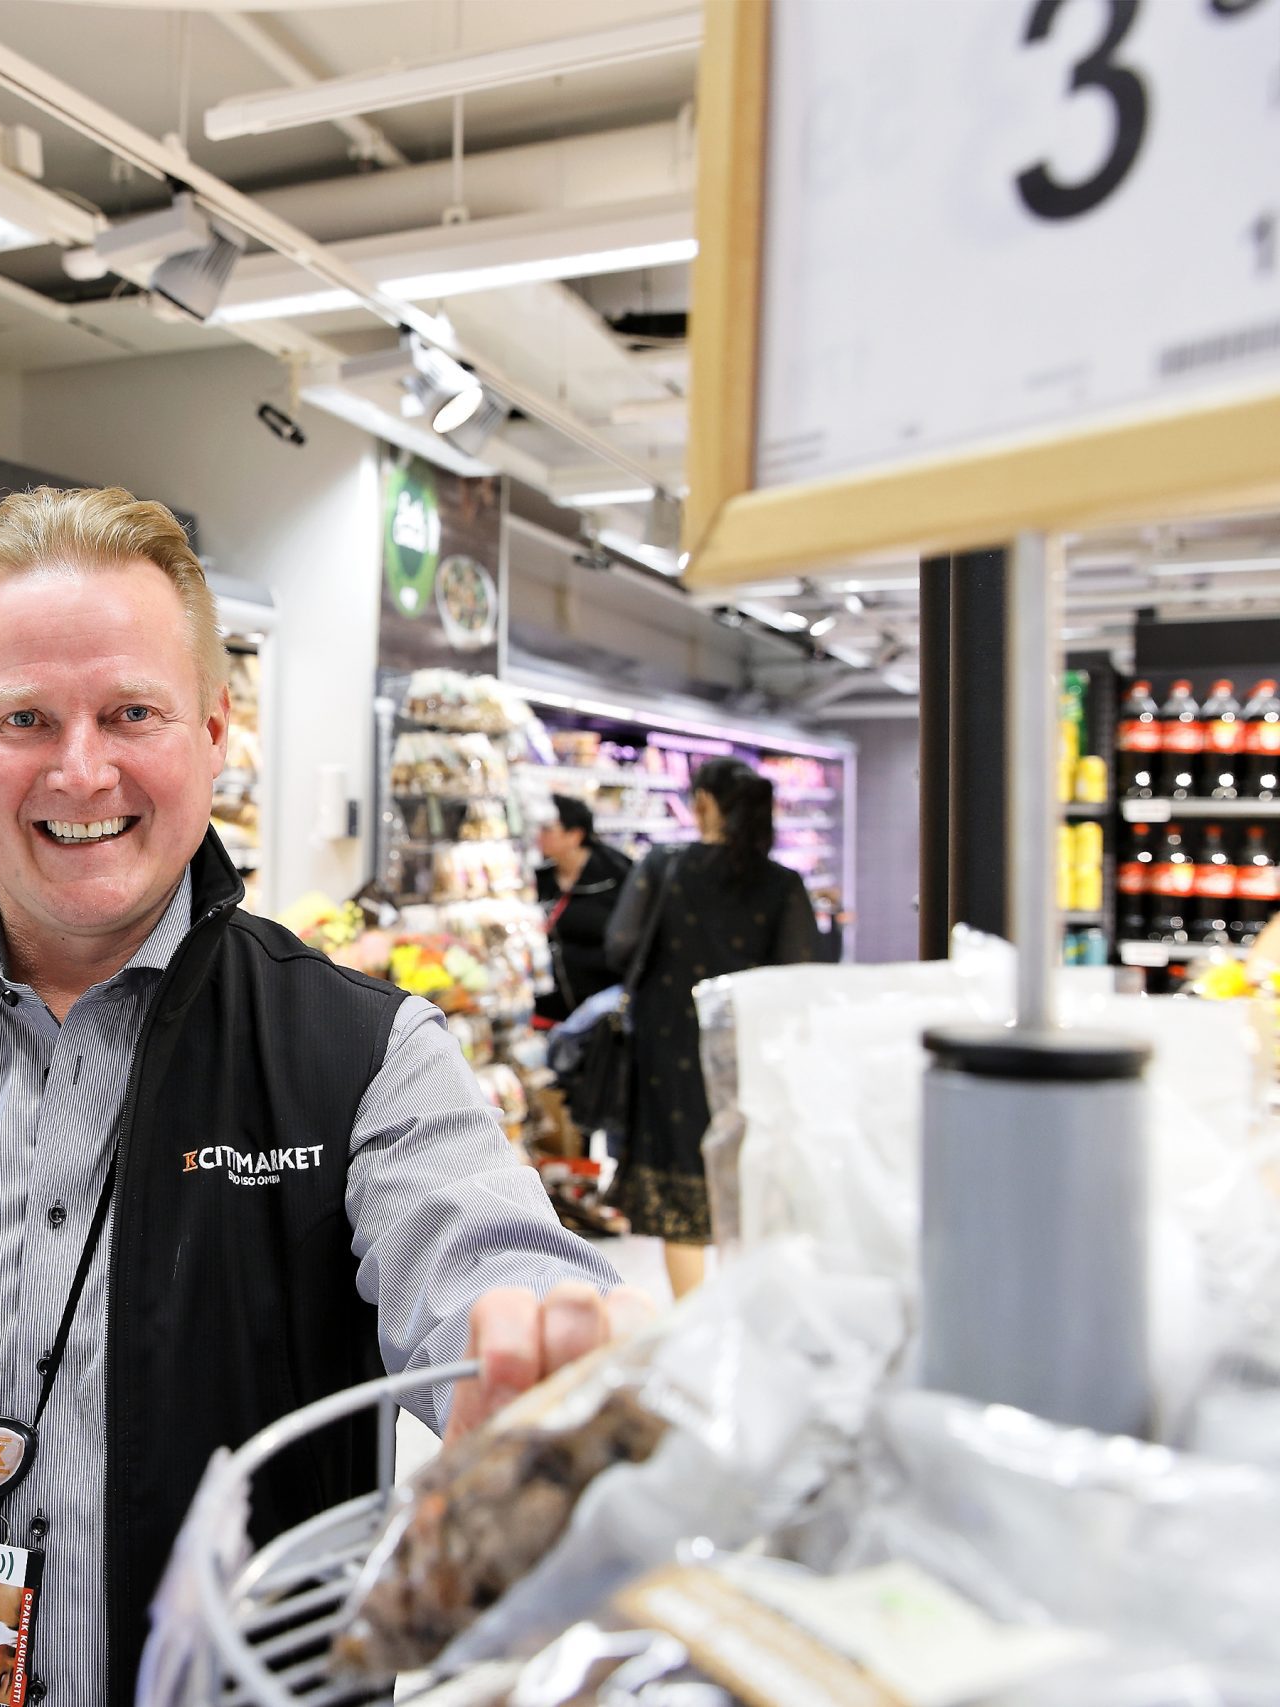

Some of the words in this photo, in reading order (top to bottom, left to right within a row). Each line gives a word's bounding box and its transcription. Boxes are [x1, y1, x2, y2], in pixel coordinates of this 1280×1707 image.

[1015, 0, 1147, 219] 3
[21, 1593, 33, 1632] Q-PARK
[13, 1635, 28, 1703] KAUSIKORTTI
